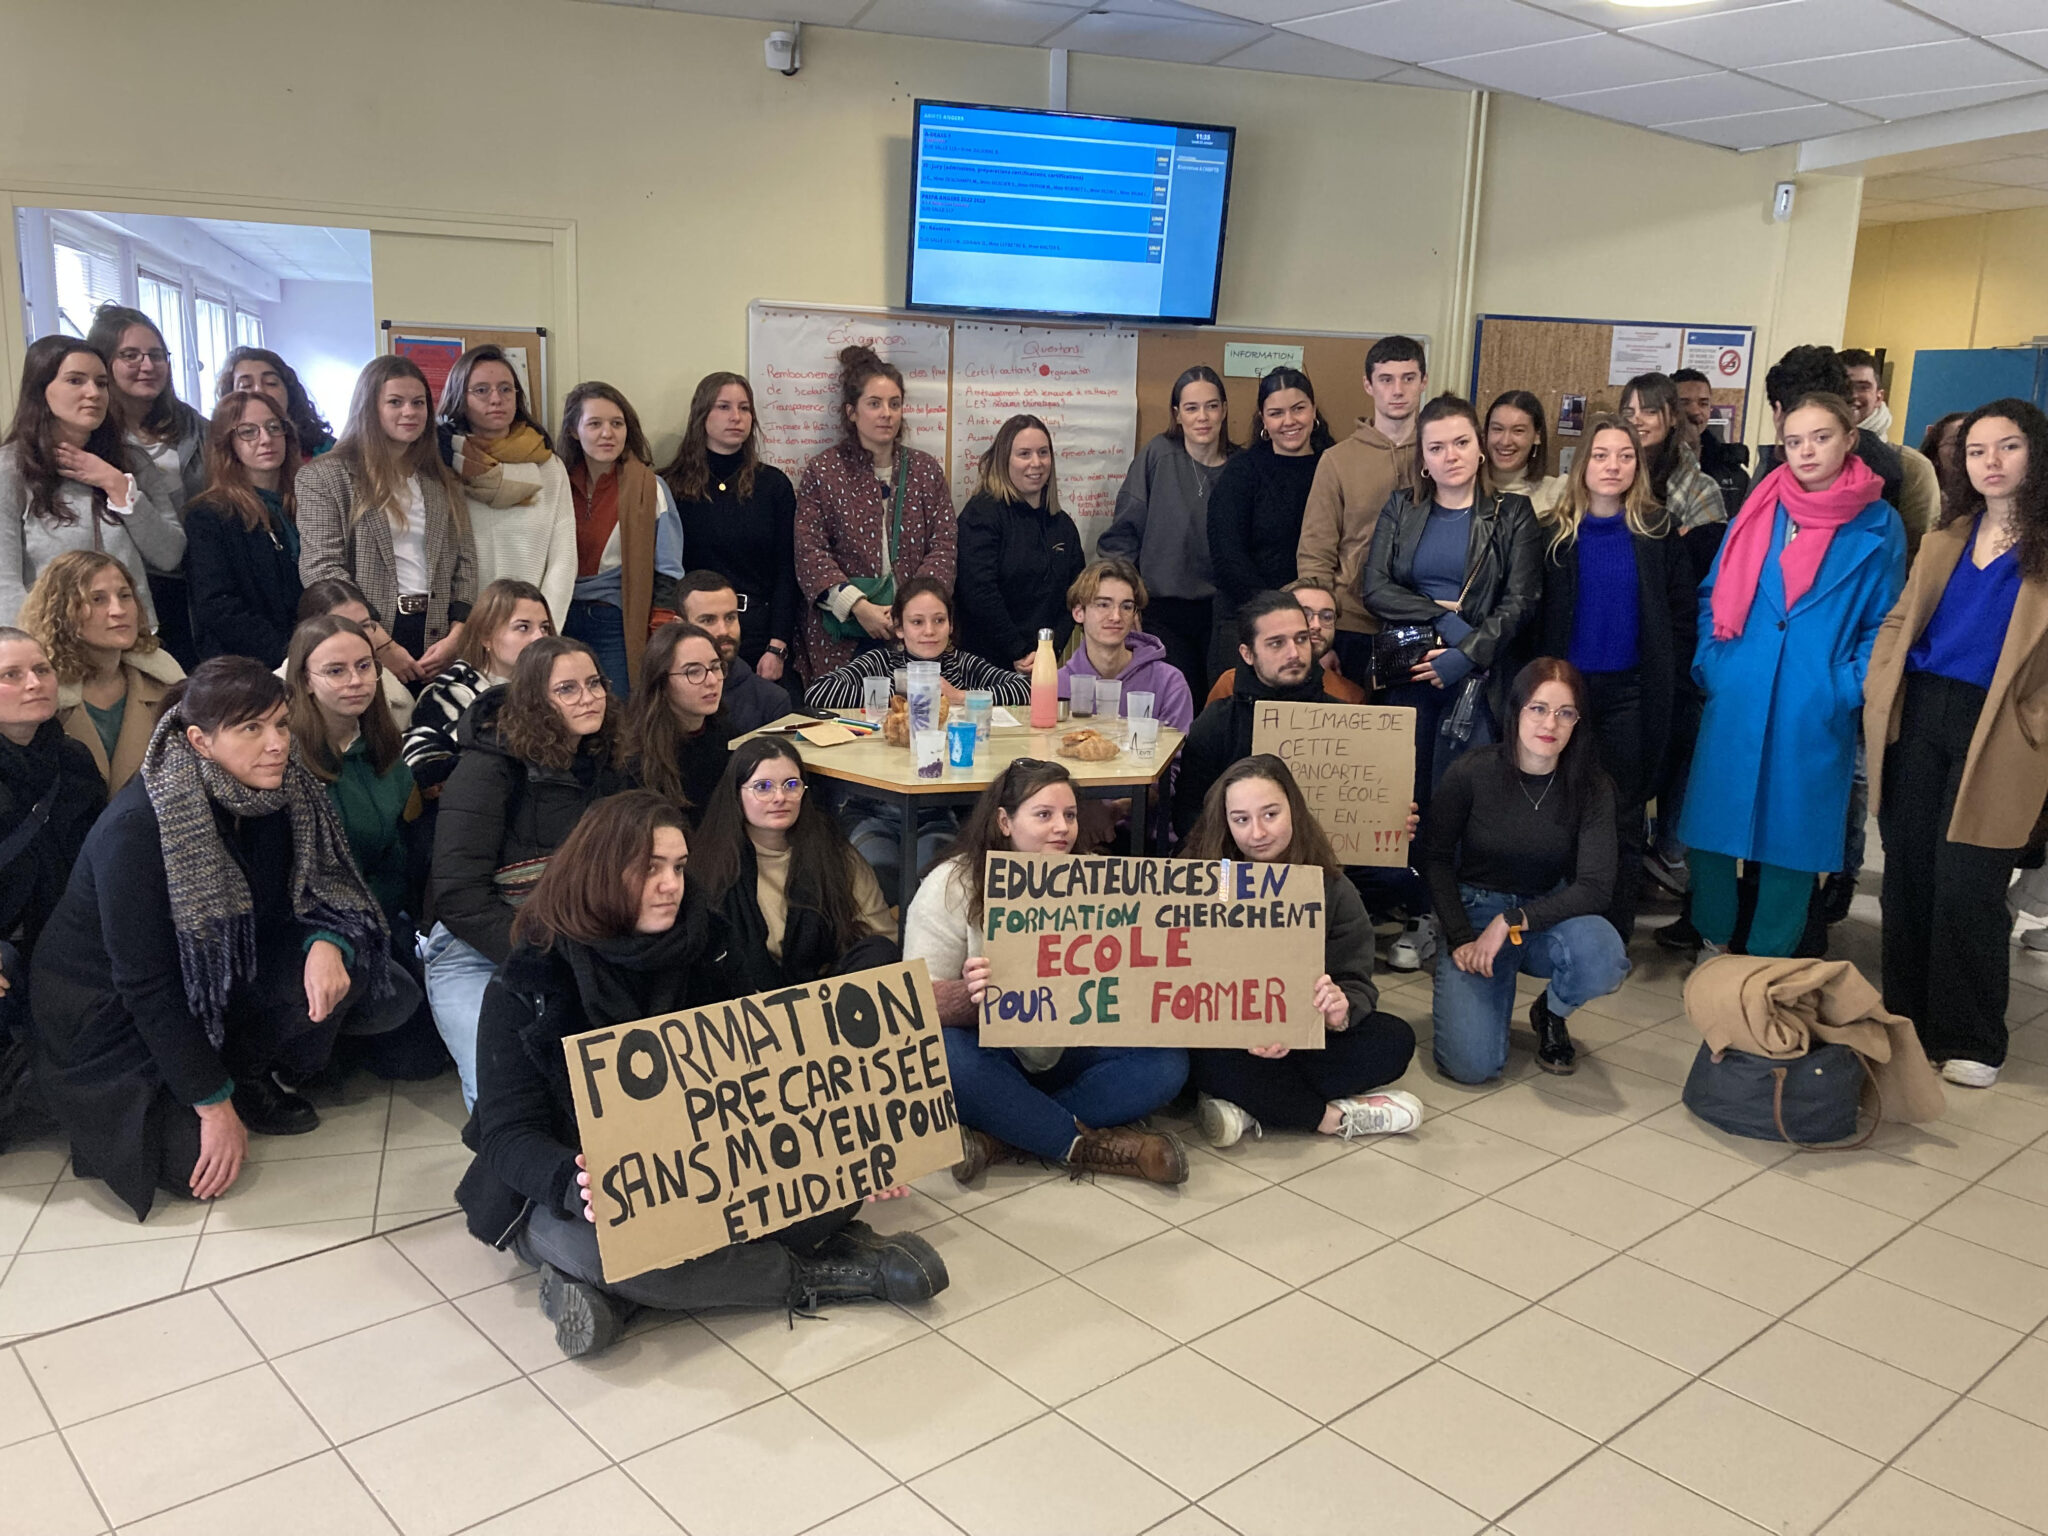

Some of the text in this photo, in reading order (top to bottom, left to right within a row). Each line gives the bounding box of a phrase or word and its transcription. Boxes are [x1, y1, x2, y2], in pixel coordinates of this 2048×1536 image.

[1023, 340, 1080, 356] Questions
[1229, 350, 1295, 360] INFORMATION
[766, 383, 782, 395] de
[1261, 707, 1404, 731] A L'IMAGE DE
[1278, 738, 1351, 760] CETTE
[1290, 763, 1383, 785] PANCARTE,
[1338, 779, 1391, 804] ÉCOLE
[1236, 863, 1290, 900] EN
[1154, 901, 1323, 929] CHERCHENT
[1036, 926, 1192, 978] ECOLE
[982, 976, 1288, 1025] POUR SE FORMER
[601, 1088, 959, 1227] SANS MOYEN POUR
